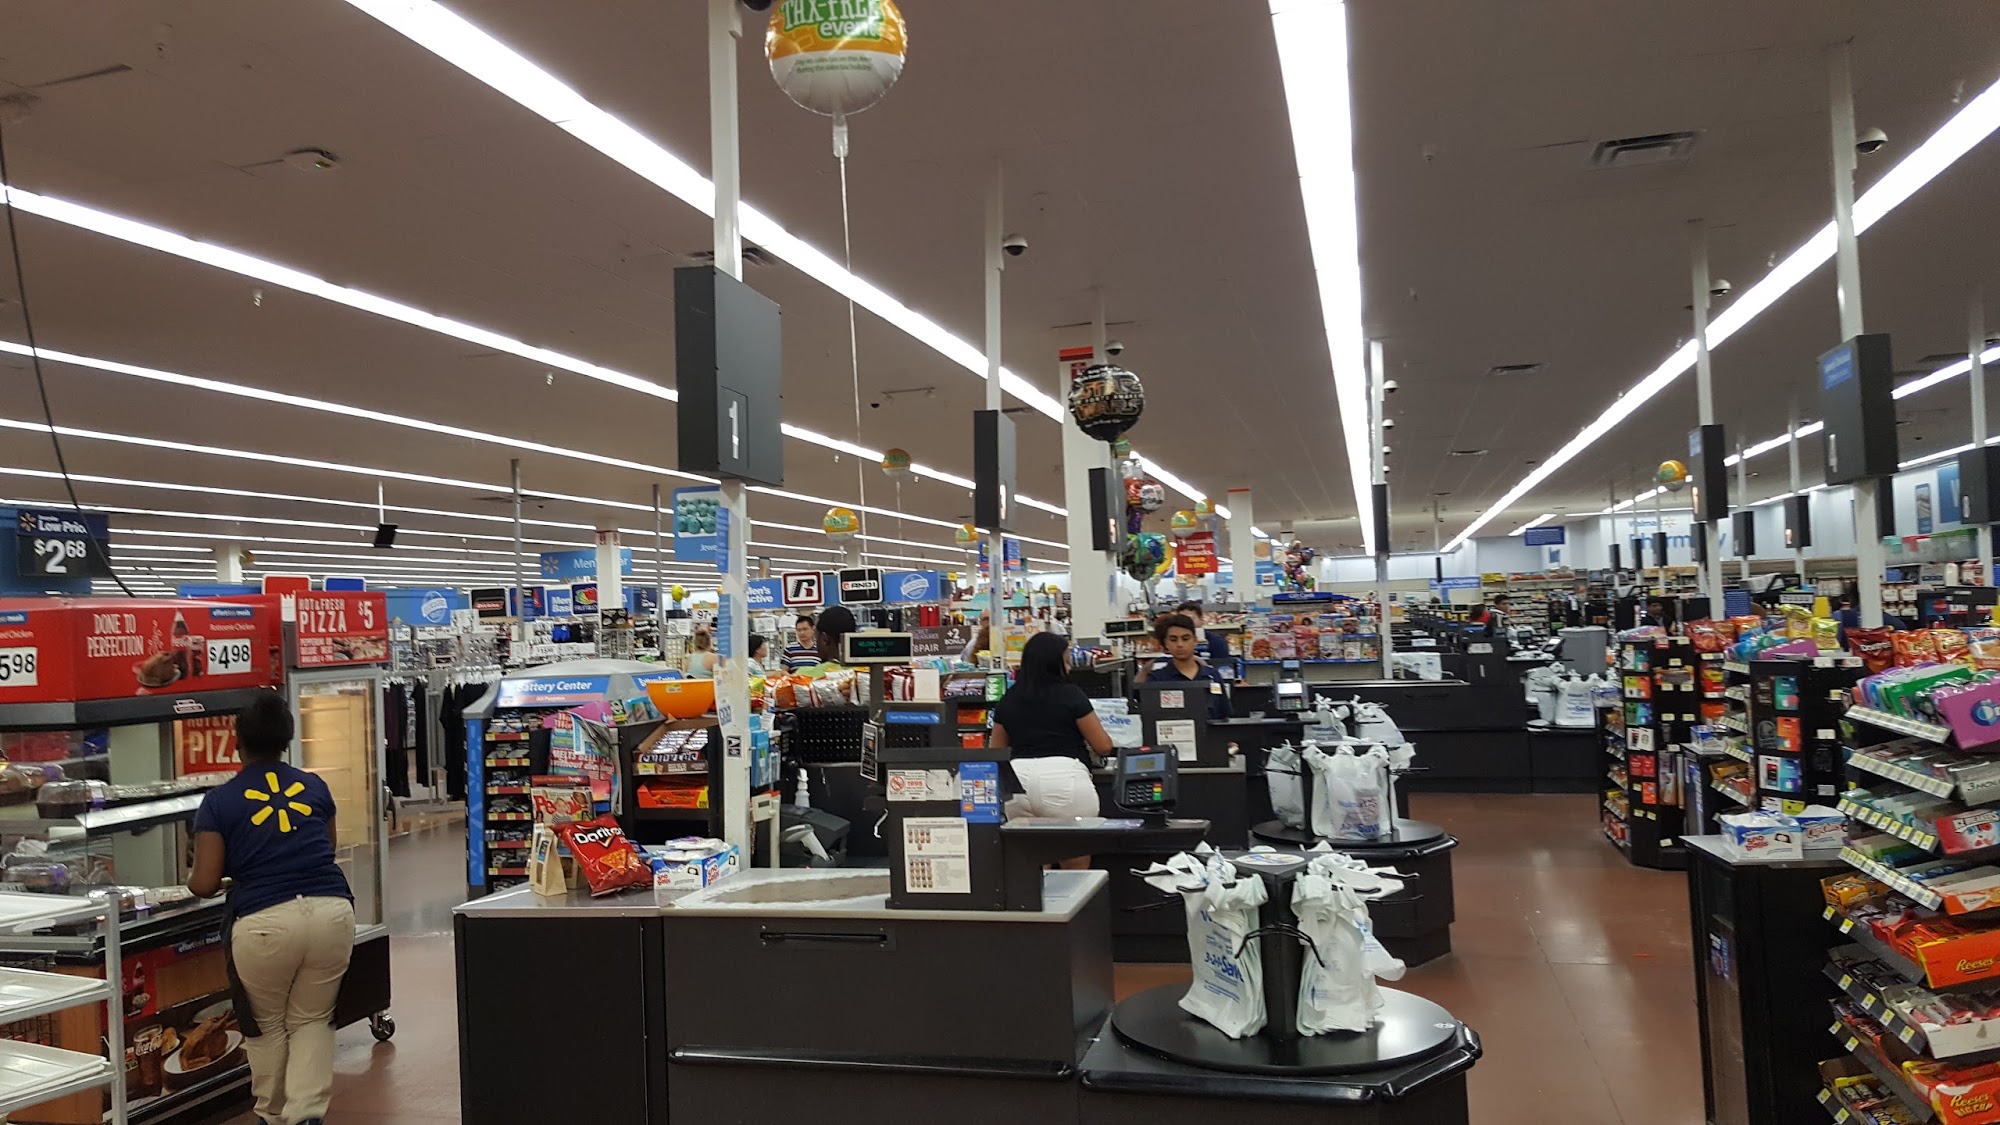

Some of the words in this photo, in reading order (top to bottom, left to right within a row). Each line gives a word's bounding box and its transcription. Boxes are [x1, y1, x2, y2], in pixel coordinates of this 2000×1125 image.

[728, 400, 740, 459] 1
[38, 520, 61, 532] Low
[93, 613, 121, 635] DONE
[123, 613, 137, 634] TO
[299, 610, 347, 633] PIZZA
[358, 600, 374, 630] $5
[86, 635, 144, 658] PERFECTION
[518, 681, 555, 693] Battery
[556, 680, 593, 691] Center
[188, 729, 242, 765] PIZ
[575, 827, 624, 844] Doritos
[1953, 1106, 1973, 1118] BIG
[1973, 1102, 1994, 1113] CUP
